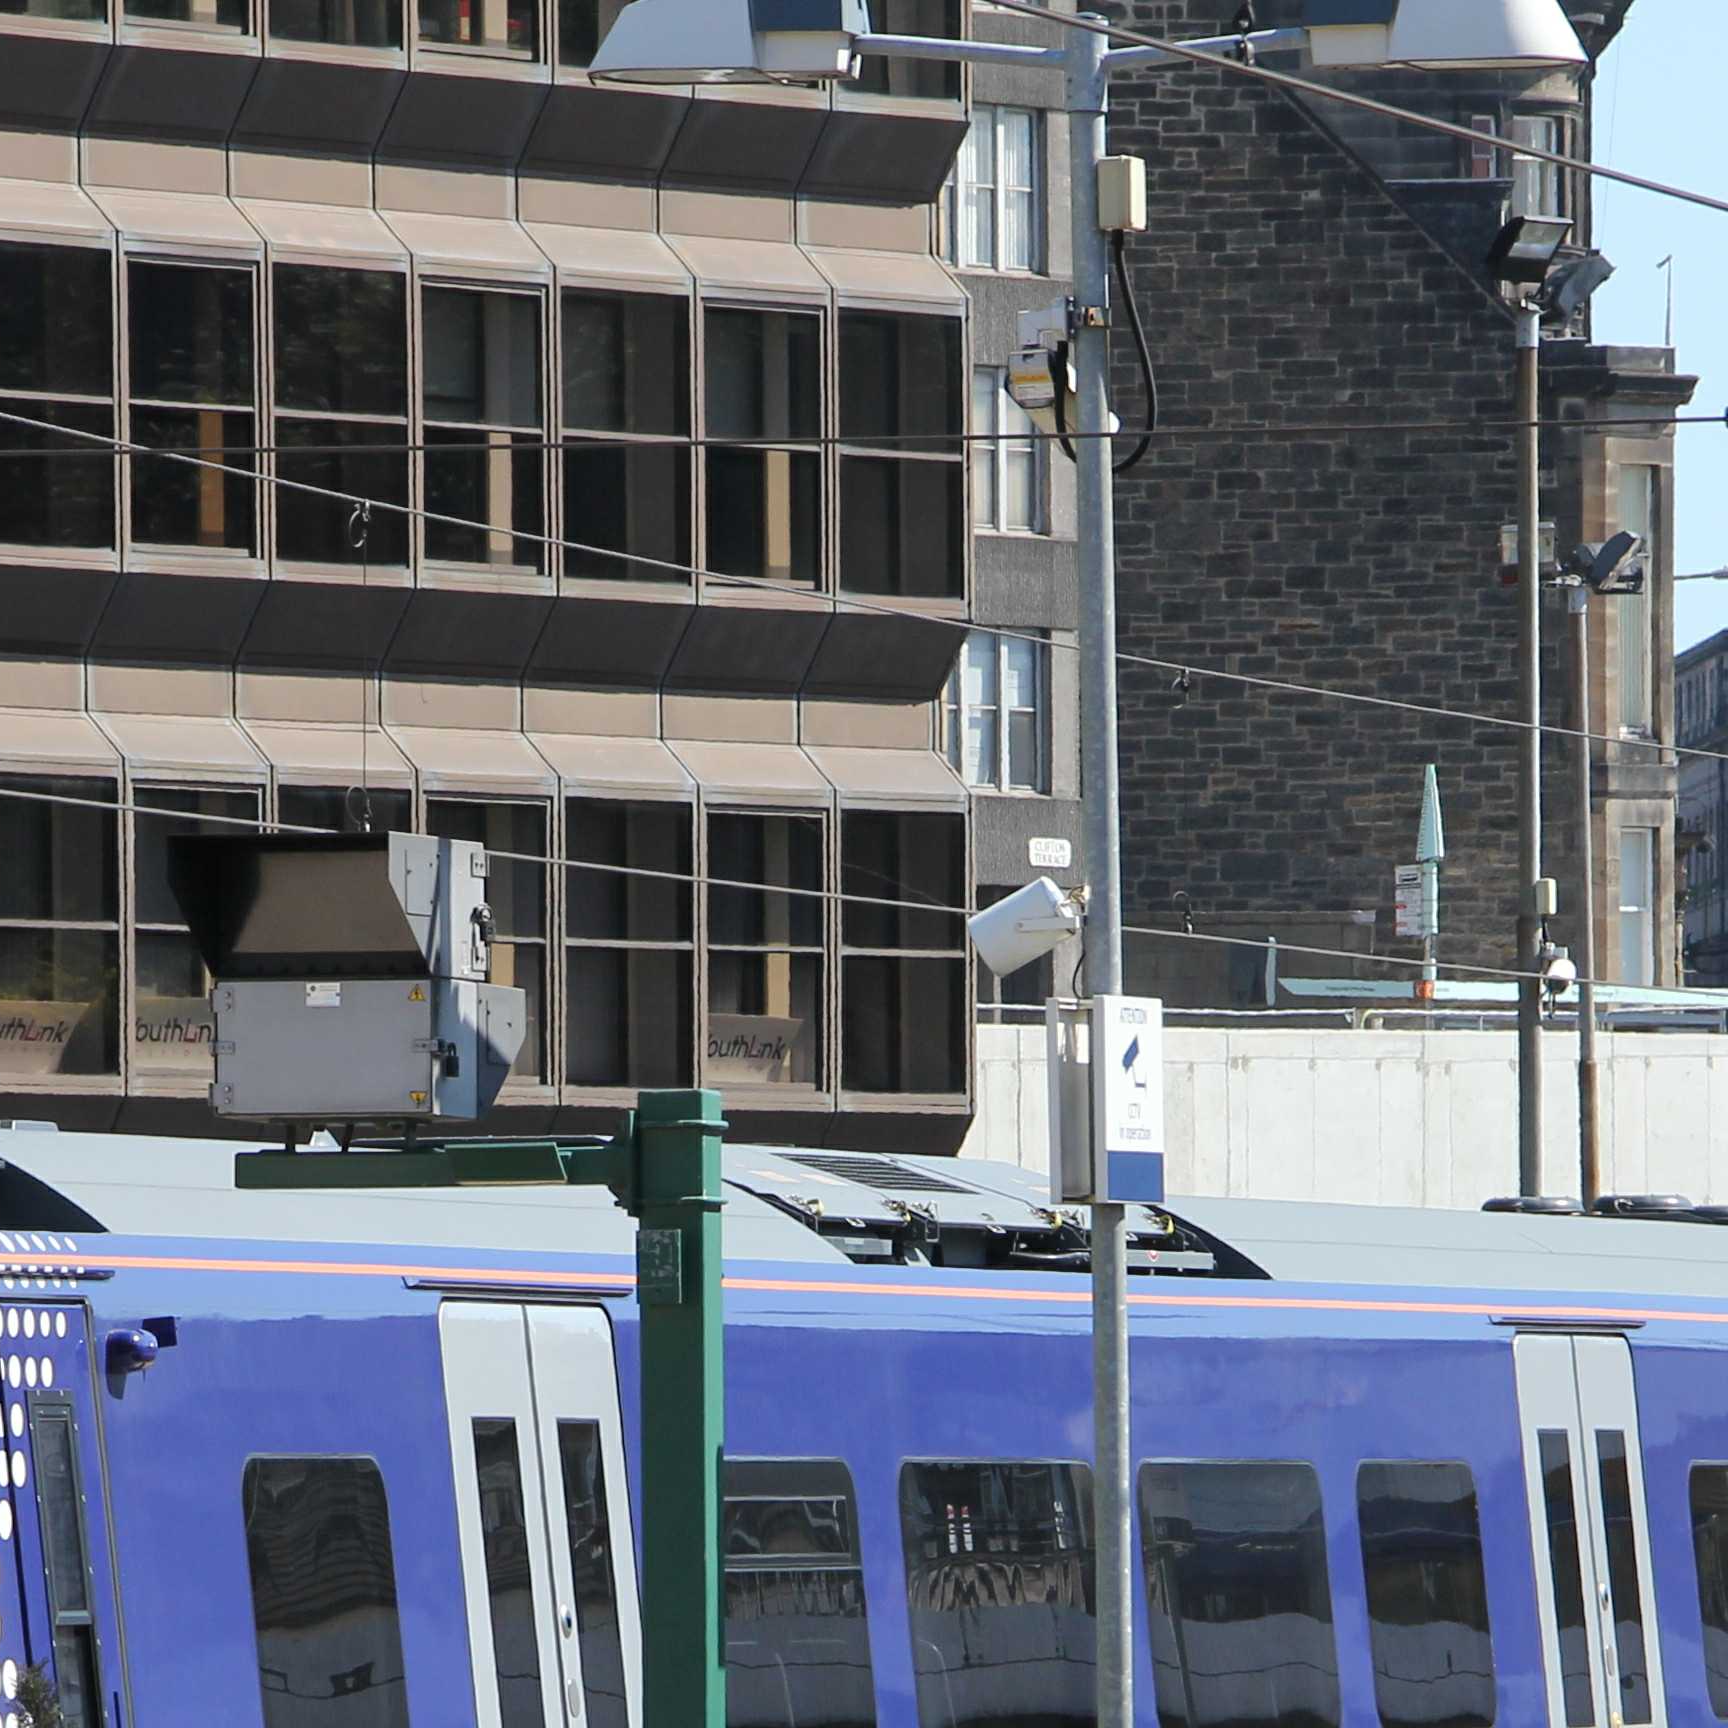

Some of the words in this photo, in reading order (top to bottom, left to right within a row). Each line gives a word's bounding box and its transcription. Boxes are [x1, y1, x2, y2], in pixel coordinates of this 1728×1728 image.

[1035, 853, 1068, 865] TERRACE
[135, 1017, 212, 1043] outhLin
[707, 1034, 786, 1060] outhLink
